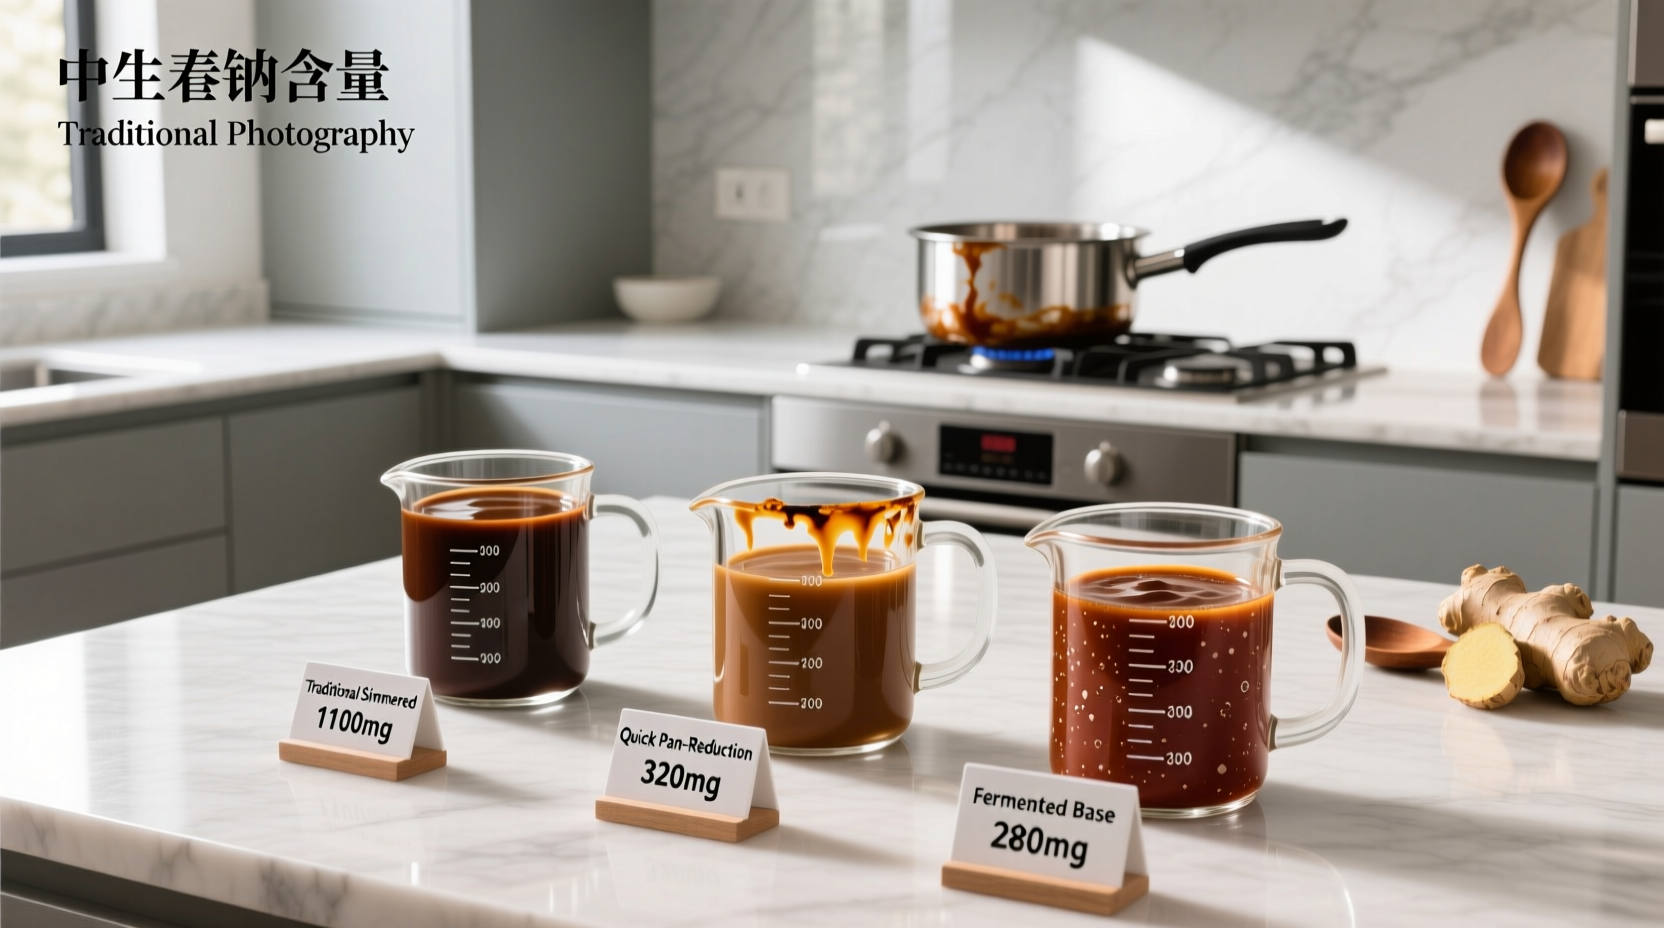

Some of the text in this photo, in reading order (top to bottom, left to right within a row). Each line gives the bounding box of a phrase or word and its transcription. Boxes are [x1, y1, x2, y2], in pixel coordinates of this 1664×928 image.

[317, 706, 393, 745] 1100mg
[619, 726, 753, 761] Quick Pan-Reduction
[640, 759, 721, 802] 320mg
[973, 787, 1116, 823] Fermented Base
[990, 820, 1089, 869] 280mg
